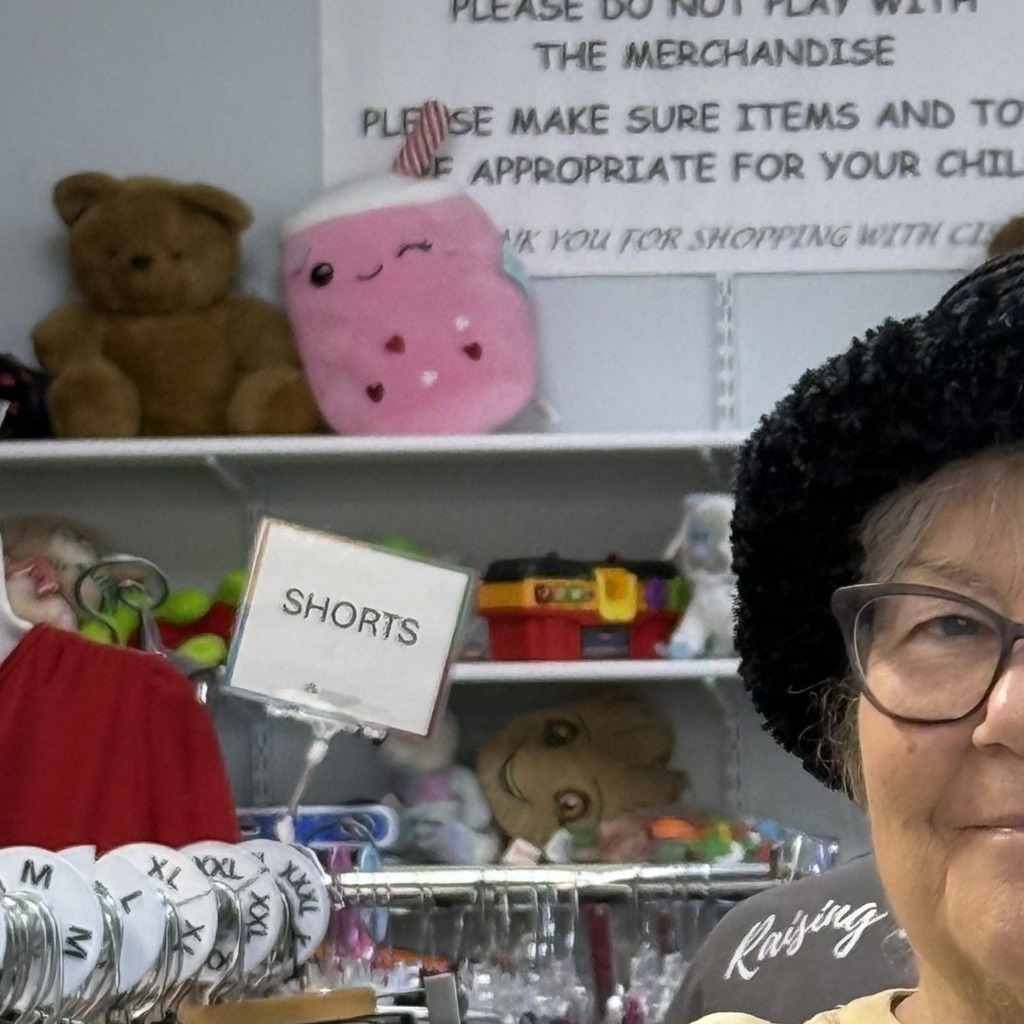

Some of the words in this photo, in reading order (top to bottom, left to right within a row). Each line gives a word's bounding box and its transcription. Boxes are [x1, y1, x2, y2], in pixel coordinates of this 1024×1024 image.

[450, 0, 584, 22] PLEASE
[602, 0, 652, 21] DO
[532, 39, 607, 71] THE
[622, 34, 896, 70] MERCHANDISE
[363, 104, 494, 138] PLESE
[511, 103, 610, 136] MAKE
[626, 102, 720, 135] SURE
[737, 100, 861, 133] ITEMS
[876, 99, 956, 130] AND
[470, 150, 716, 186] APPROPRIATE
[732, 151, 804, 182] FOR
[820, 149, 921, 180] YOUR
[551, 228, 612, 252] YOU
[618, 226, 682, 254] FOR
[688, 223, 851, 250] SHOPPING
[857, 221, 941, 248] WITH
[282, 588, 420, 646] SHORTS
[20, 858, 54, 890] M
[147, 855, 182, 891] XL
[192, 855, 244, 880] XXL
[119, 889, 143, 915] L
[246, 890, 270, 944] XXL
[63, 923, 93, 959] M
[723, 899, 889, 981] Raising
